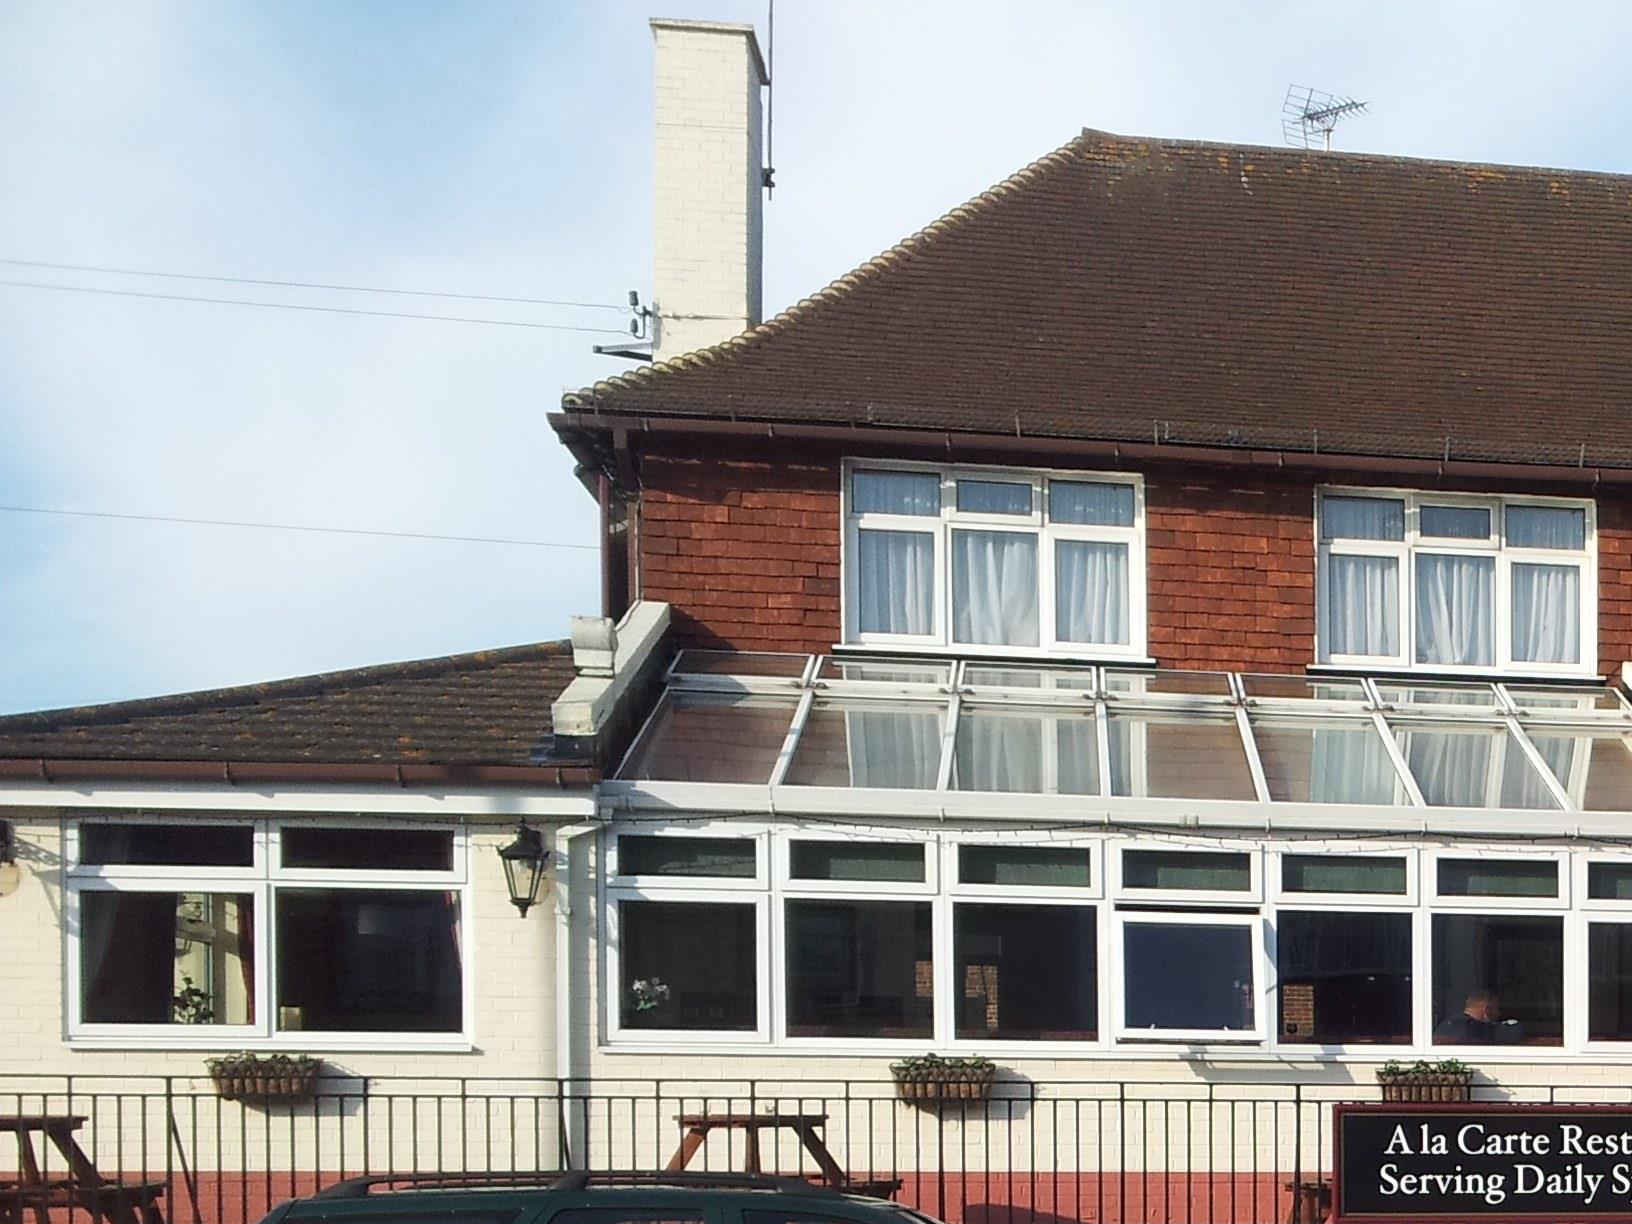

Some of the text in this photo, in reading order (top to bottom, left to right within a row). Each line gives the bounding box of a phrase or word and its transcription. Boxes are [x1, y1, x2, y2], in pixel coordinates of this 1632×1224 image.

[1383, 1125, 1414, 1155] A
[1420, 1125, 1448, 1155] la
[1457, 1125, 1550, 1155] Carte
[1379, 1165, 1505, 1203] Serving
[1514, 1164, 1603, 1204] Daily
